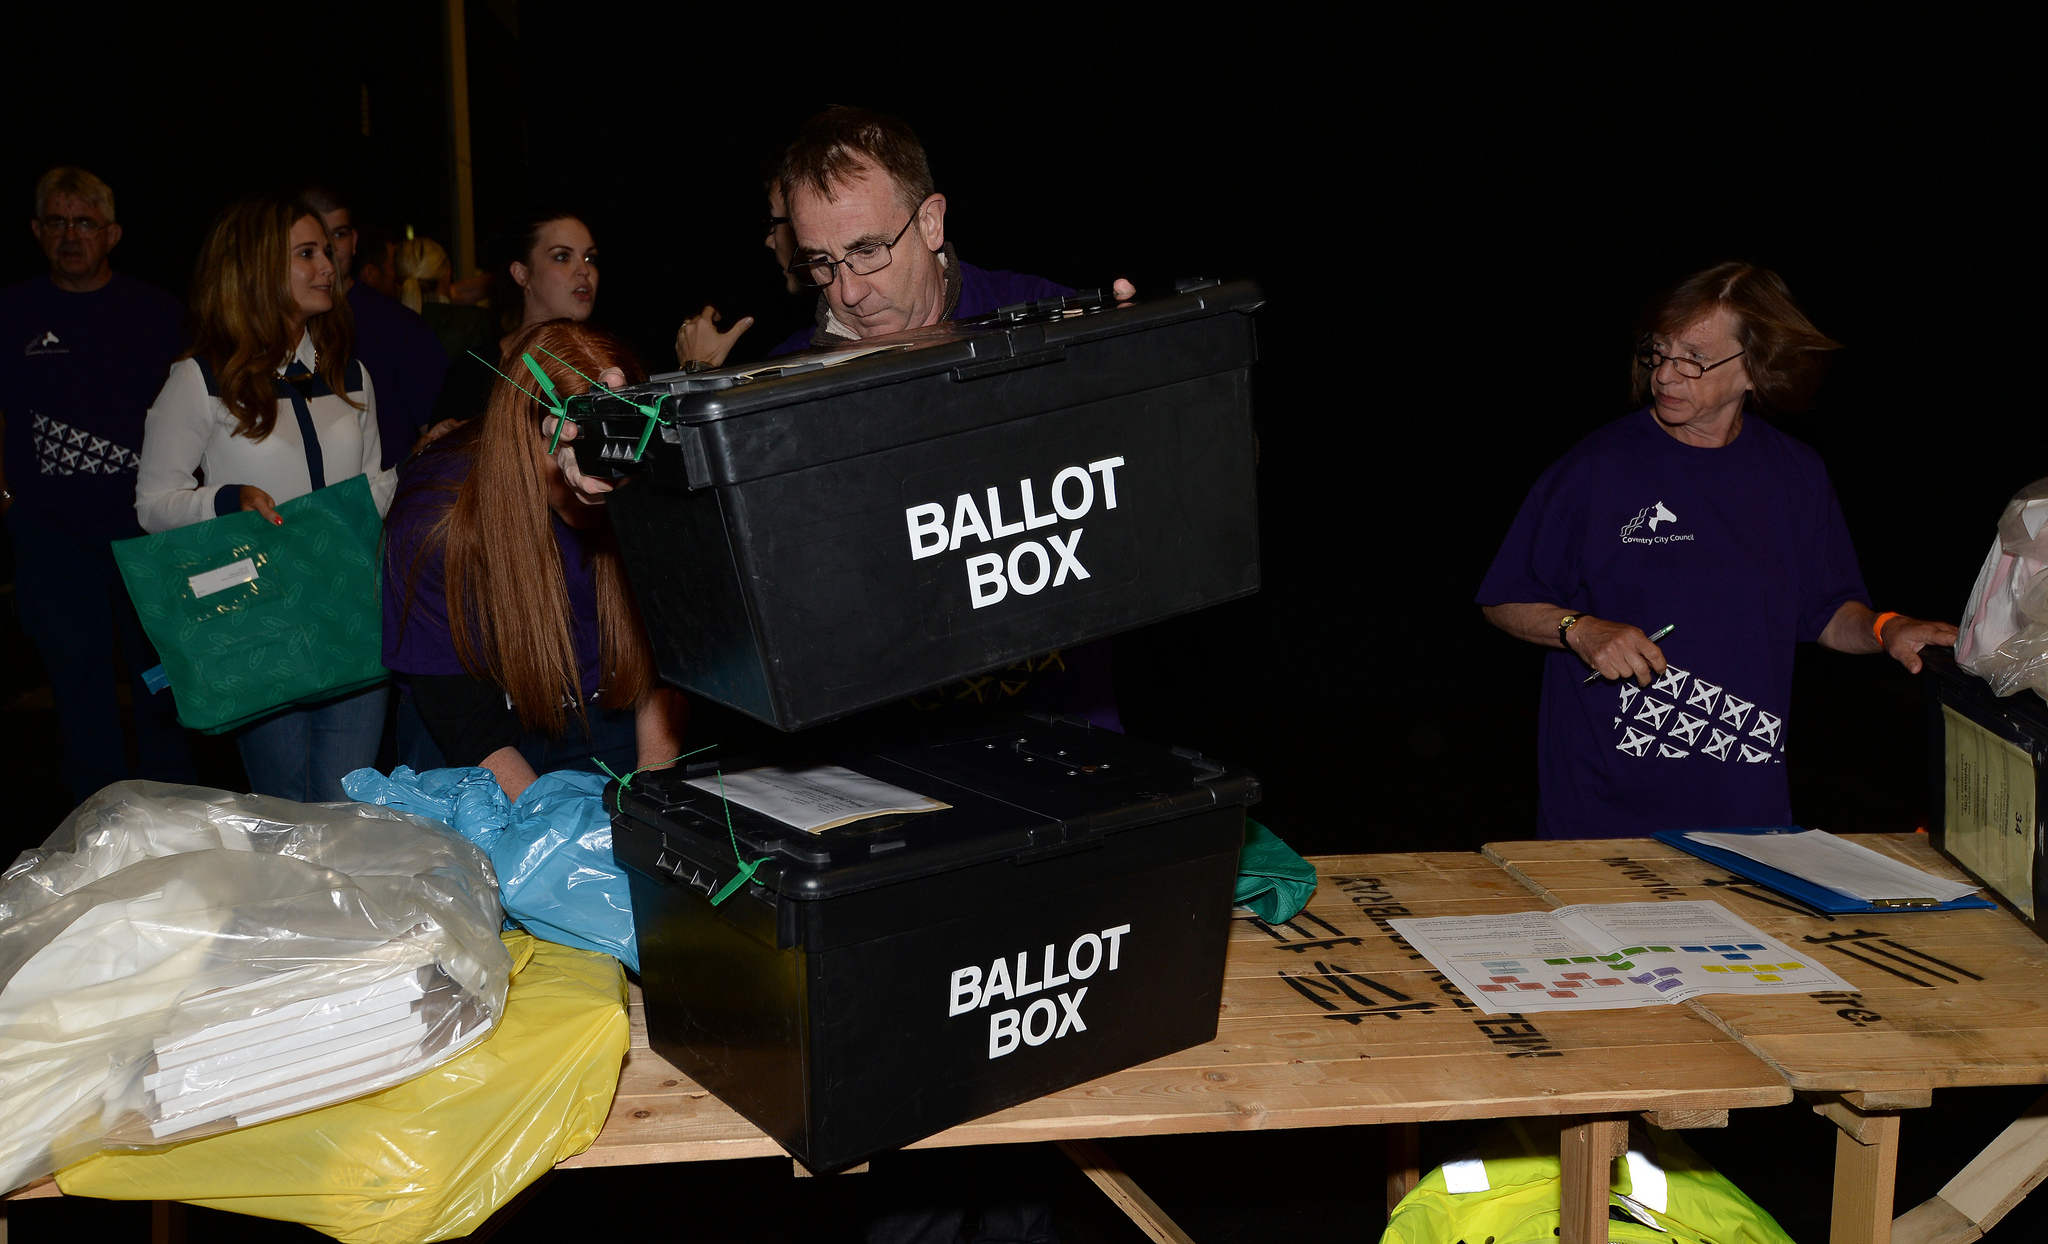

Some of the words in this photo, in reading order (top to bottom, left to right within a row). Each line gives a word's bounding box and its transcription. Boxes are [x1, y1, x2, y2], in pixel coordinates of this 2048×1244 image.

[905, 455, 1125, 561] BALLOT
[1622, 536, 1653, 546] Coventry
[1653, 536, 1669, 544] City
[1669, 534, 1695, 542] Council
[965, 527, 1091, 610] BOX
[2015, 811, 2022, 835] 34
[949, 923, 1131, 1018] BALLOT
[1602, 856, 1688, 899] www.
[1808, 991, 1884, 1027] ire.
[988, 986, 1089, 1060] BOX
